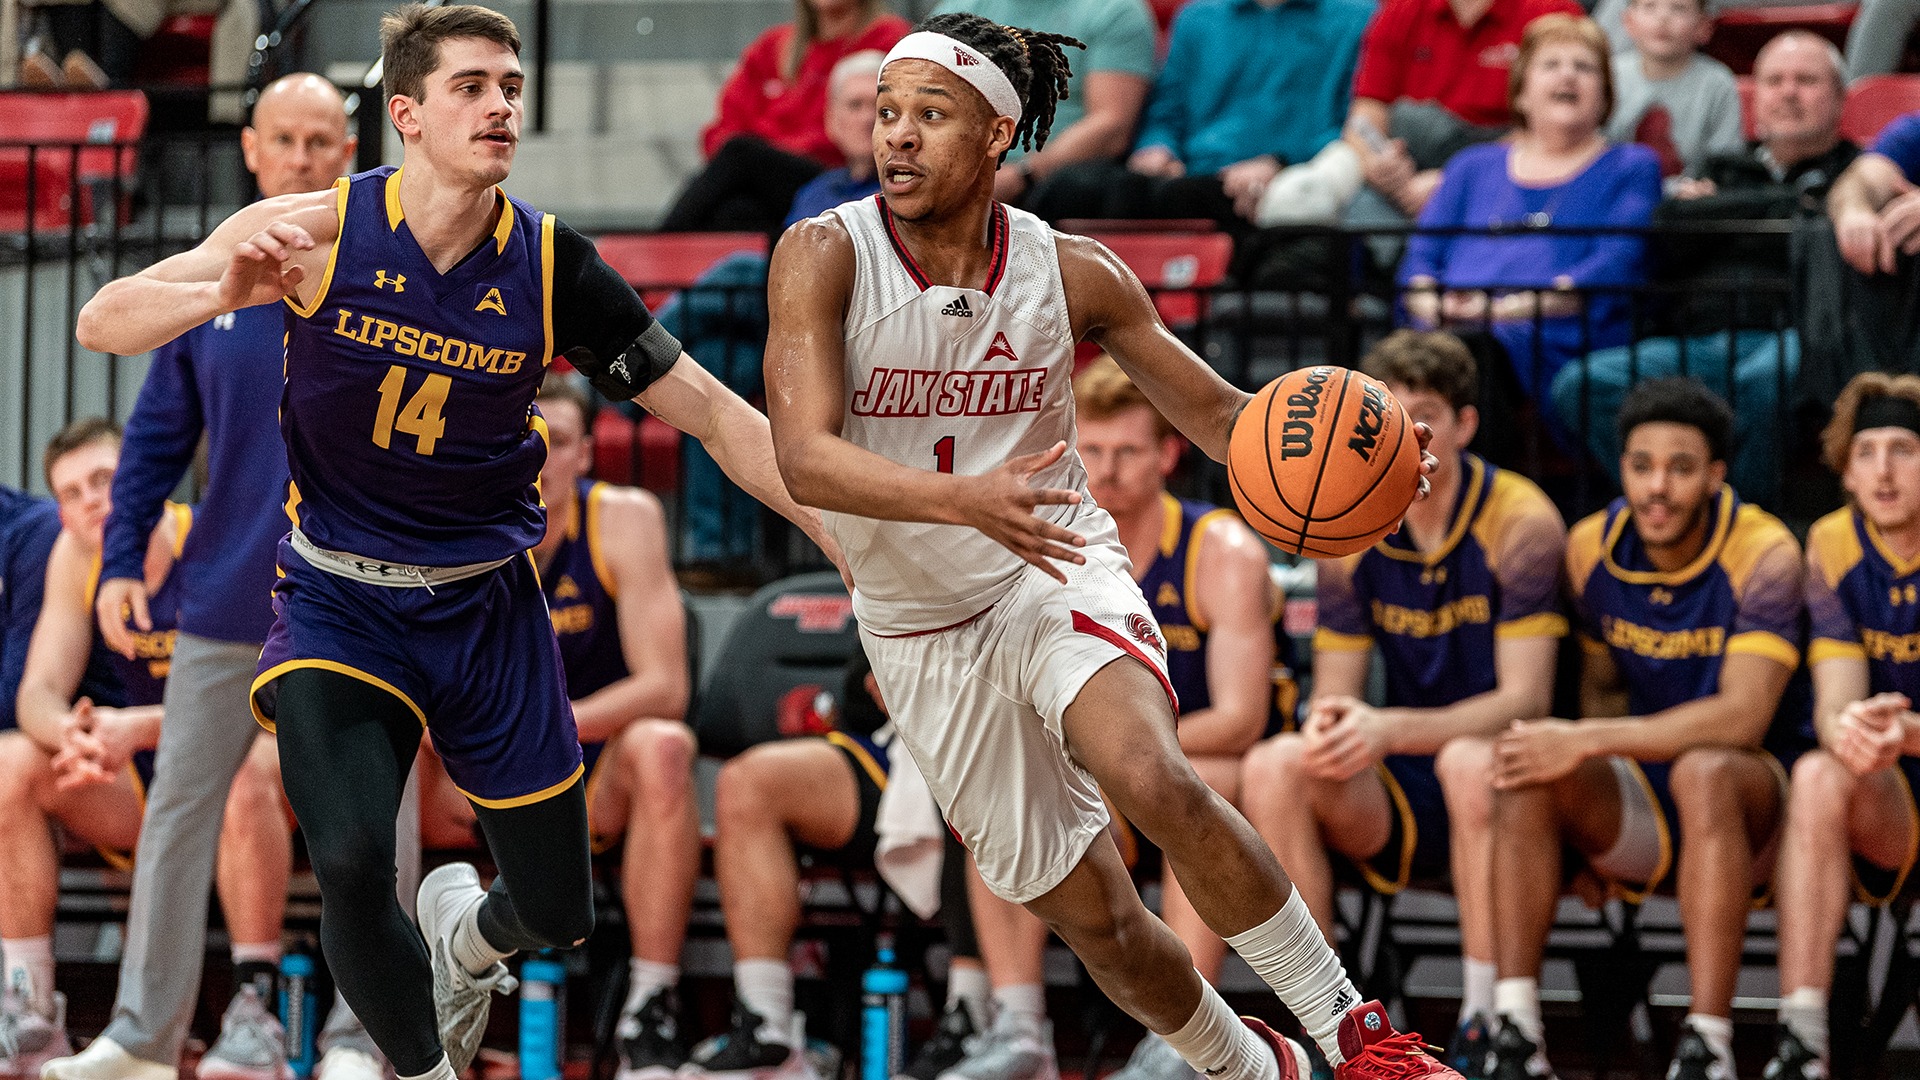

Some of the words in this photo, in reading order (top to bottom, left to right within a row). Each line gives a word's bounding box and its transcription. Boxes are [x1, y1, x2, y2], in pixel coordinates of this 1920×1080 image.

[333, 308, 527, 374] LIPSCOMB
[372, 364, 453, 456] 14
[851, 366, 942, 418] JAX
[935, 366, 1049, 417] STATE
[1281, 367, 1337, 461] Wilson
[1347, 381, 1388, 463] NCAA
[933, 435, 956, 475] 1
